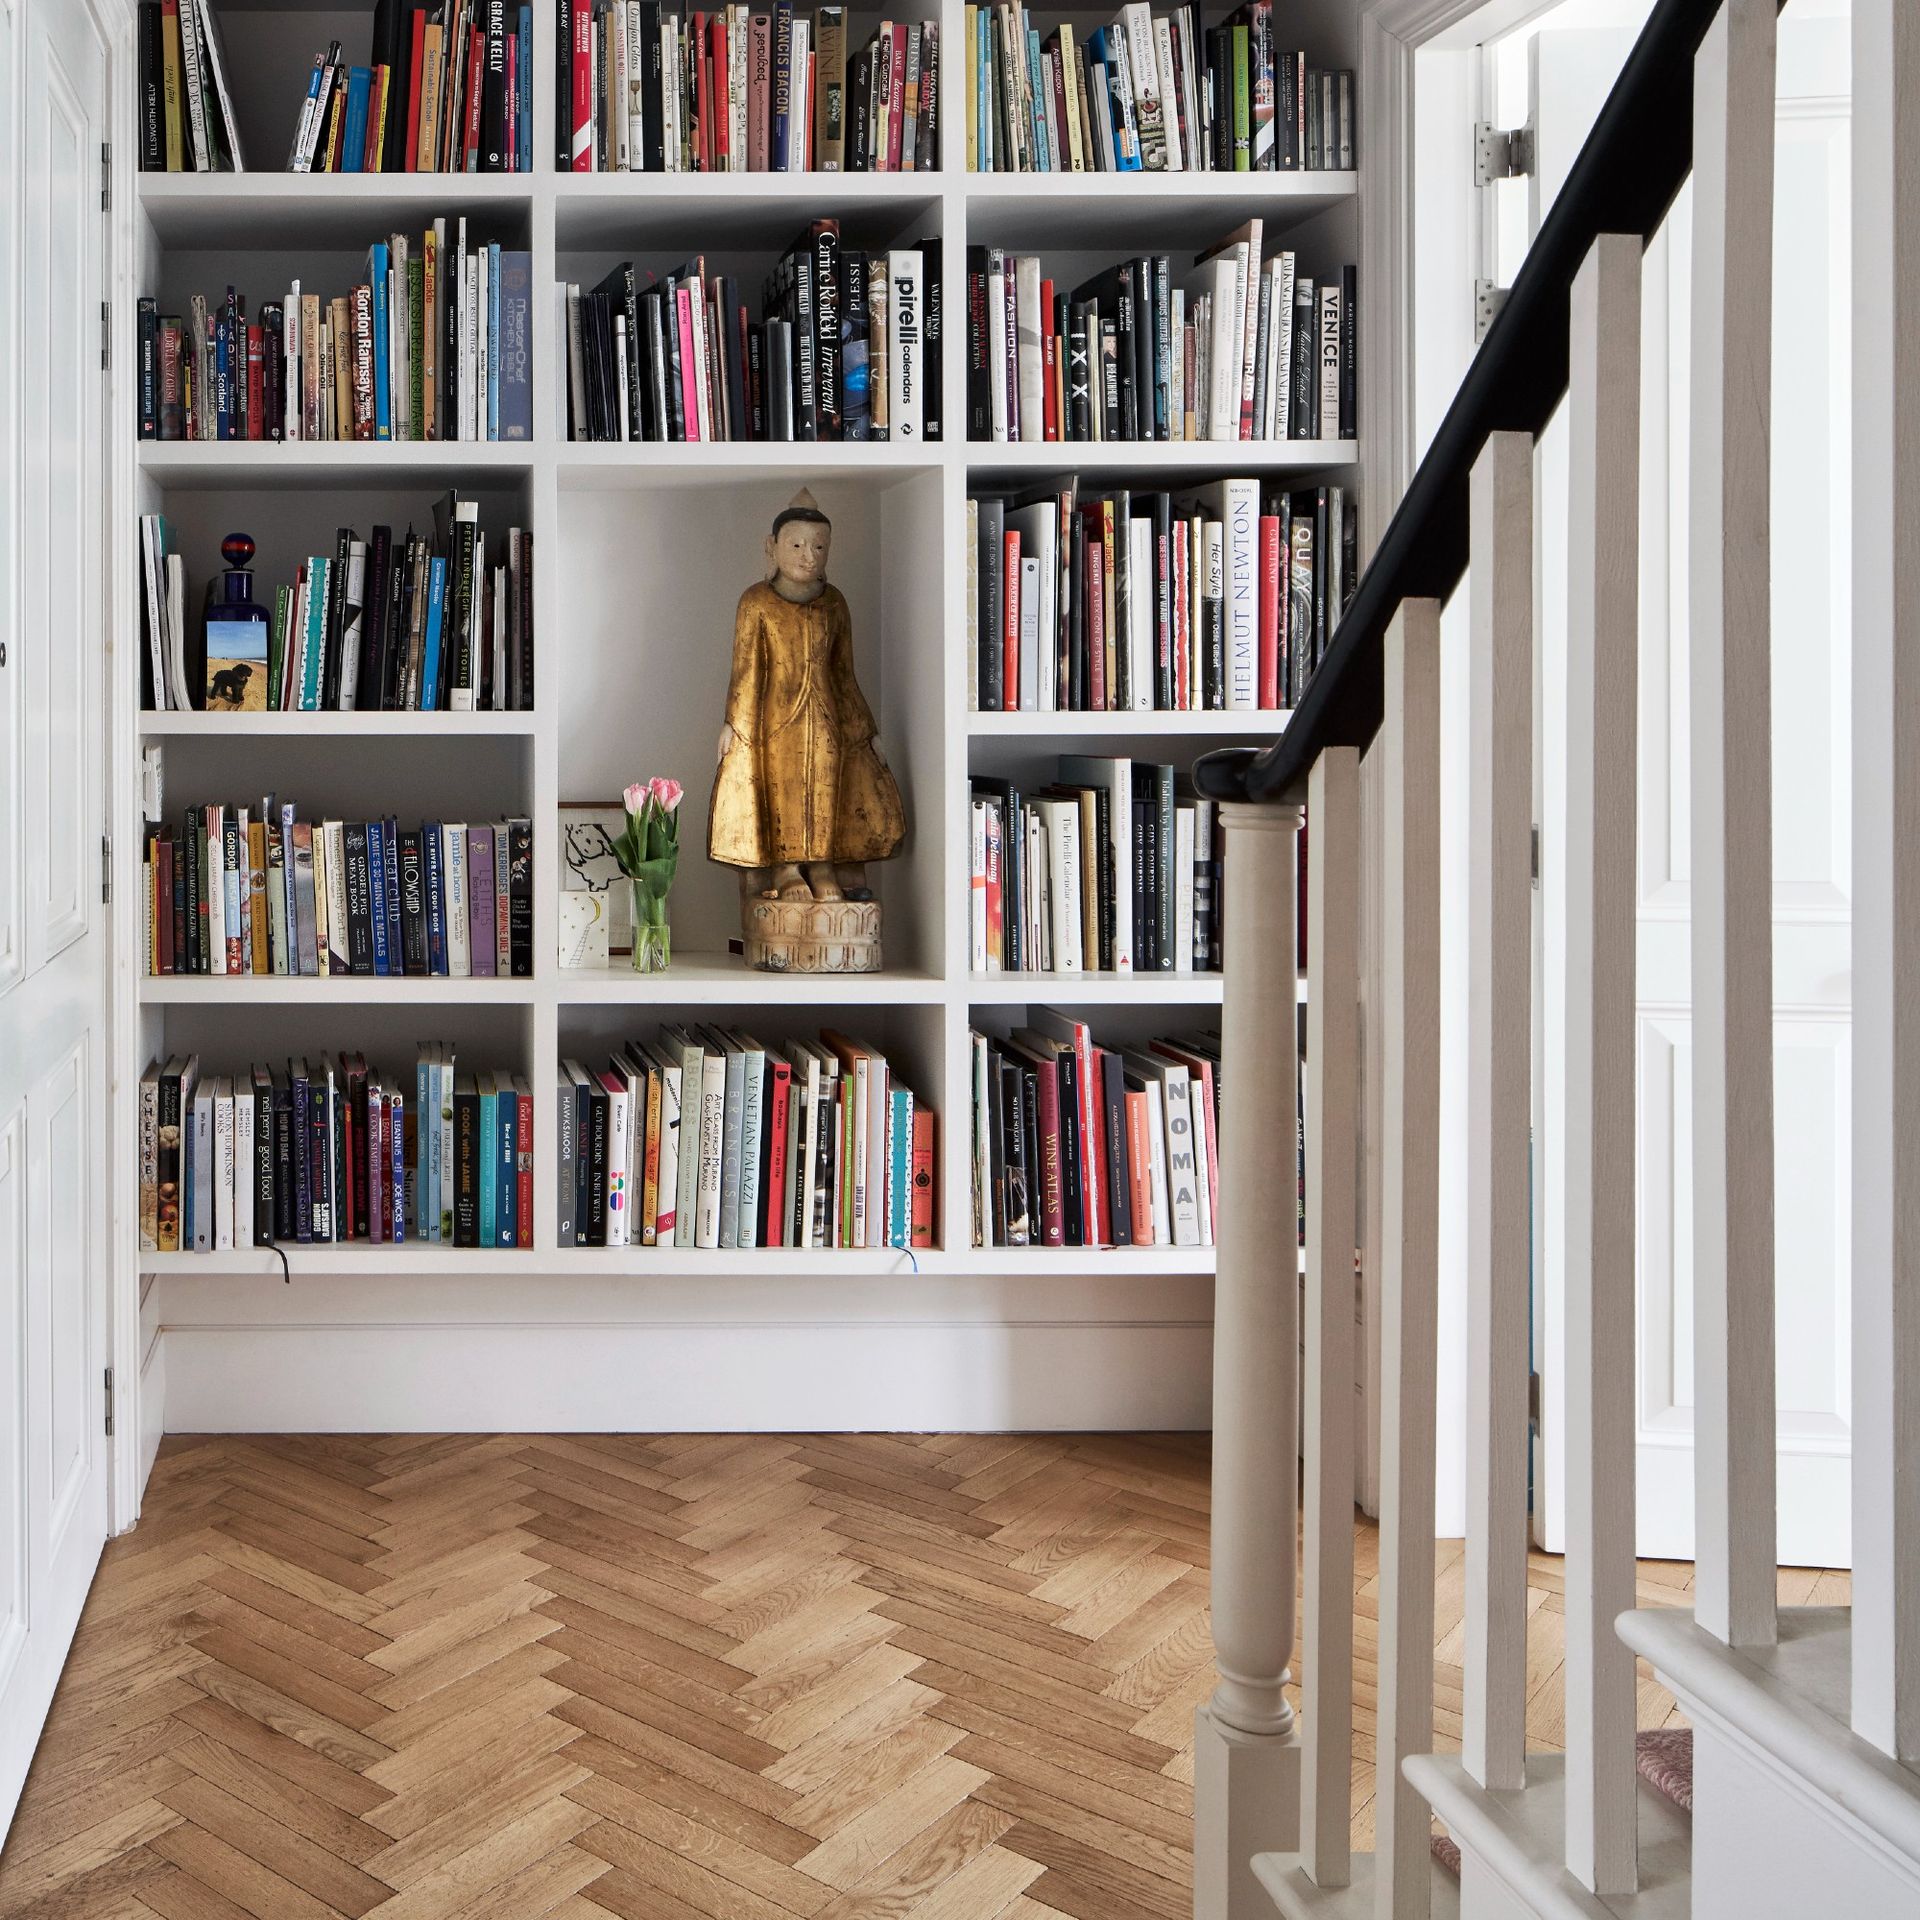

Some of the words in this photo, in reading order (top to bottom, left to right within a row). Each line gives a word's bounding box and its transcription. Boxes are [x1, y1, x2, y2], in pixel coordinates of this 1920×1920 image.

[490, 1, 502, 36] GRACE
[629, 8, 640, 44] Orrefors
[777, 9, 790, 64] FRANCIS
[426, 50, 436, 94] Sustainable
[490, 40, 502, 72] KELLY
[631, 45, 640, 70] Glass
[820, 27, 835, 82] WINE
[909, 32, 919, 81] DRINKS
[149, 83, 157, 106] KELLY
[316, 75, 331, 118] BARCELONA
[426, 96, 434, 122] School
[776, 70, 789, 115] BACON
[893, 78, 902, 112] decorate
[922, 72, 930, 111] HOLIDAY
[149, 108, 157, 155] ELLSWORTH
[819, 232, 835, 282] Carine
[1158, 260, 1166, 274] THE
[1237, 251, 1246, 283] Radical
[850, 263, 859, 310] PLESSI
[1158, 276, 1167, 316] ENORMOUS
[1236, 285, 1245, 318] Fashion
[1248, 281, 1258, 330] TESTINO
[357, 290, 371, 338] Gordon
[819, 285, 836, 339] Roitfeld
[895, 279, 917, 344] pirelli
[1007, 296, 1016, 358] FASHION
[1159, 317, 1167, 343] GUITAR
[164, 331, 175, 357] TAROT
[411, 322, 422, 346] FOR
[516, 298, 526, 384] MasterChef
[1324, 295, 1337, 368] VENICE
[357, 339, 371, 392] Ramsay
[411, 350, 422, 380] EASY
[821, 346, 838, 414] irreverent
[902, 346, 912, 404] calendars
[1159, 344, 1168, 383] SONGBOOK
[1243, 333, 1255, 400] PORTRAITS
[219, 373, 227, 412] Scotland
[463, 525, 471, 553] PETER
[1211, 543, 1220, 564] Her
[1234, 501, 1248, 600] NEWTON
[1269, 529, 1277, 583] GALLIANO
[1296, 527, 1310, 593] QUAY
[462, 557, 470, 610] LINDBERGH
[1159, 580, 1167, 599] TONY
[1211, 567, 1221, 596] Style
[1094, 637, 1101, 648] OF
[1234, 610, 1250, 702] HELMUT
[460, 648, 468, 687] STORIES
[498, 832, 506, 849] TOM
[989, 808, 998, 836] Sonia
[226, 831, 235, 870] GORDON
[332, 829, 342, 871] Honestly
[371, 827, 380, 868] JAMIE'S
[384, 839, 398, 883] sugar
[449, 830, 461, 866] jamie
[988, 837, 998, 883] Delaunay
[349, 857, 357, 885] MEAT
[358, 857, 366, 895] GINGER
[453, 876, 462, 904] home
[498, 850, 507, 894] KERRIDGE'S
[334, 873, 343, 910] Healthy
[350, 888, 358, 916] BOOK
[373, 869, 383, 920] 30-MINUTE
[389, 889, 400, 922] club
[479, 869, 492, 926] LEITHS
[499, 896, 507, 936] DOPAMINE
[376, 923, 385, 957] MEALS
[500, 937, 508, 954] DIET
[262, 1096, 271, 1112] neil
[280, 1114, 288, 1131] HOW
[462, 1107, 470, 1135] COOK
[519, 1102, 528, 1120] food
[746, 1075, 758, 1145] VENETIAN
[144, 1093, 152, 1175] CHEESE
[260, 1115, 270, 1139] perry
[280, 1133, 288, 1142] TO
[505, 1139, 511, 1148] of
[594, 1125, 602, 1164] BOURDIN
[1168, 1082, 1192, 1205] NOMA
[225, 1135, 233, 1186] HOPKINSON
[259, 1146, 272, 1172] good
[280, 1143, 289, 1162] BAKE
[370, 1143, 378, 1174] SIMPLE
[462, 1138, 470, 1159] with
[725, 1090, 740, 1208] BRANCUSI
[1046, 1133, 1057, 1170] WINE
[262, 1175, 272, 1200] food
[462, 1162, 470, 1193] JAMIE
[743, 1152, 755, 1205] PALAZZI
[1047, 1173, 1059, 1214] ATLAS
[313, 1204, 321, 1232] GORDON
